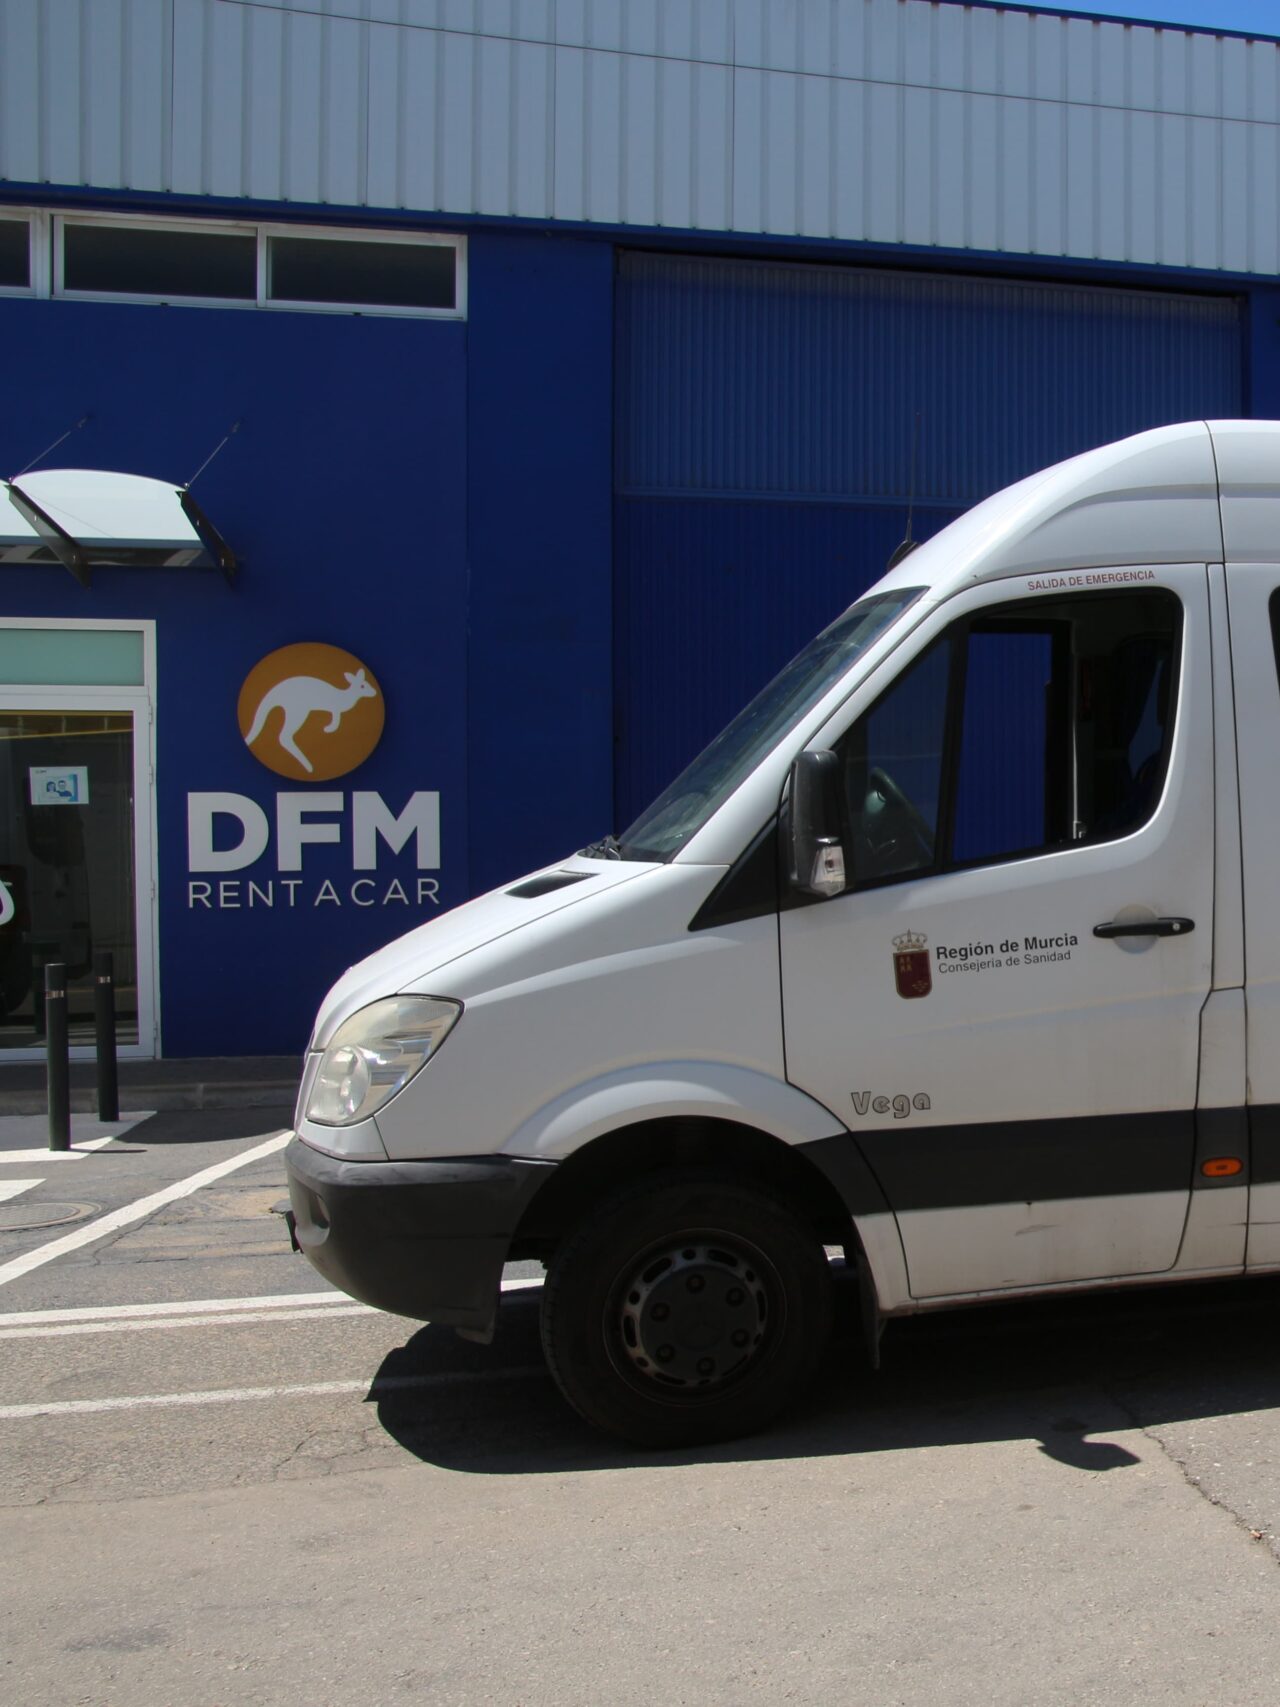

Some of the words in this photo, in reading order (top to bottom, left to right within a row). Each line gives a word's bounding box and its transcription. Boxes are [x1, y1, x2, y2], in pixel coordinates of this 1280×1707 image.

[1027, 579, 1066, 591] SALIDA
[1069, 576, 1083, 586] DE
[1086, 570, 1155, 585] EMERGENCIA
[187, 791, 441, 872] DFM
[188, 880, 303, 908] RENT
[313, 879, 342, 907] A
[350, 878, 440, 906] CAR
[936, 942, 994, 961] Región
[999, 939, 1019, 953] de
[1024, 932, 1078, 951] Murcia
[1005, 956, 1020, 967] de
[1024, 949, 1071, 965] Sanidad
[851, 1091, 931, 1119] Vega
